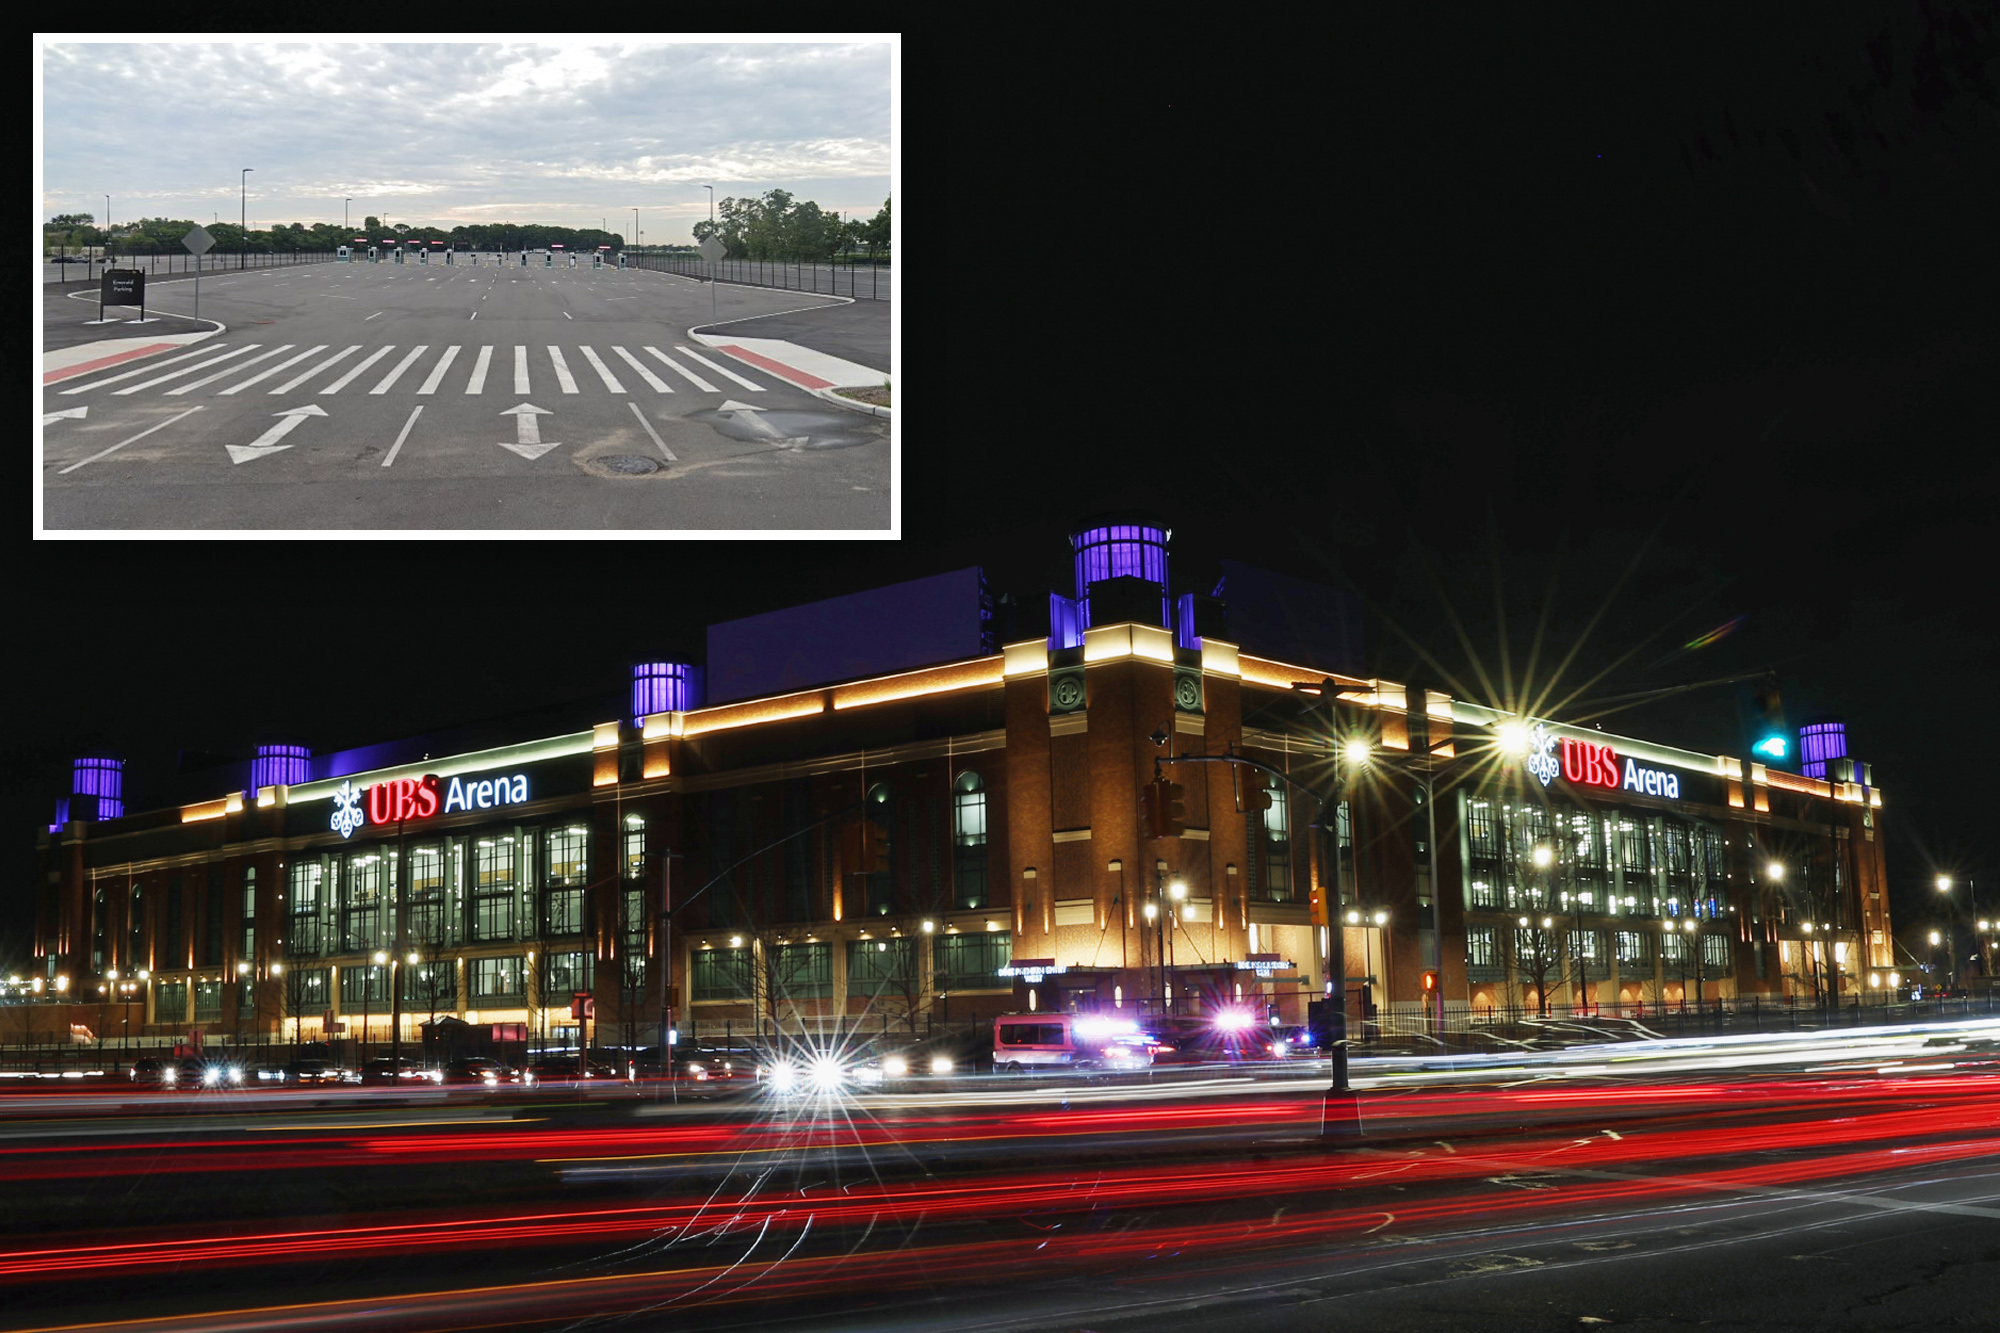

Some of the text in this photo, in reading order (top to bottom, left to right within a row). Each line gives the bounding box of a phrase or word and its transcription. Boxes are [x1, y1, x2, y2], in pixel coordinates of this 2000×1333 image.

[1560, 737, 1680, 799] UBS Arena
[369, 773, 529, 825] UBS Arena
